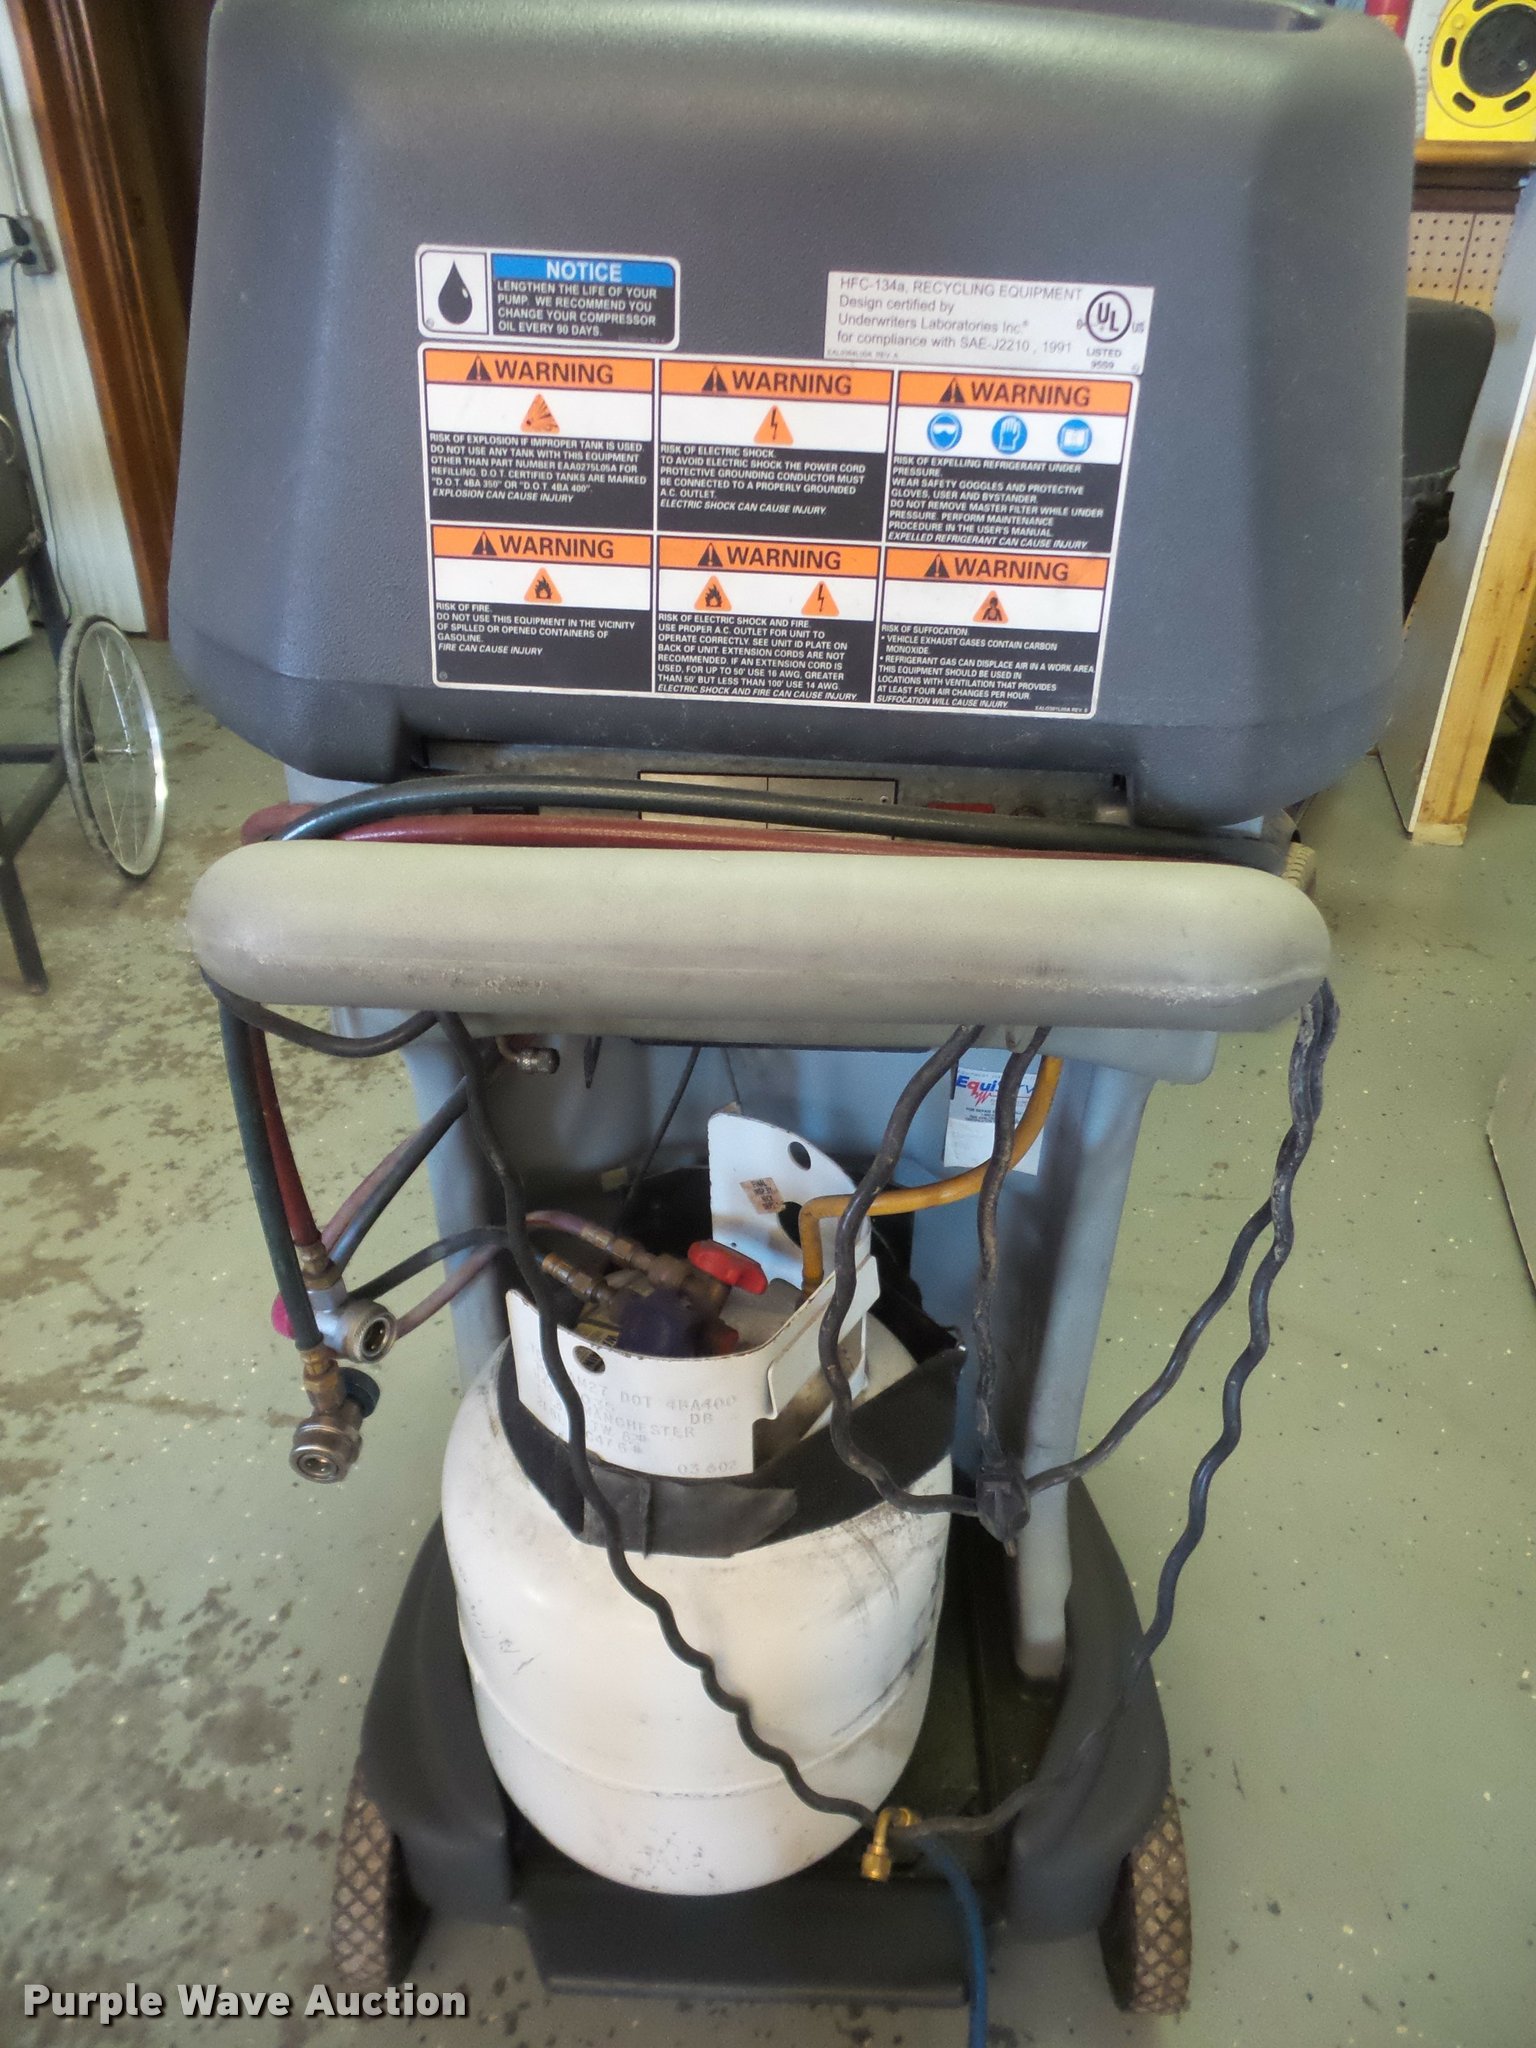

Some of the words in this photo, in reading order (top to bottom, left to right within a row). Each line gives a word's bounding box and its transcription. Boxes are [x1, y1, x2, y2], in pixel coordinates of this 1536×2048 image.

[547, 262, 621, 282] NOTICE
[498, 282, 555, 294] LENGTHEN
[559, 284, 579, 295] THE
[582, 286, 604, 297] LIFE
[608, 287, 622, 297] OF
[626, 288, 657, 299] YOUR
[912, 281, 994, 296] RECYCLING
[999, 285, 1082, 300] EQUIPMENT
[535, 296, 551, 307] WE
[555, 297, 625, 310] RECOMMEND
[629, 301, 651, 312] YOU
[840, 295, 882, 310] Design
[886, 298, 935, 312] certified
[939, 300, 954, 313] by
[498, 308, 542, 320] CHANGE
[546, 310, 576, 322] YOUR
[579, 312, 655, 326] COMPRESSOR
[839, 313, 916, 328] Underwriters
[921, 317, 997, 332] Laboratories
[1098, 302, 1119, 332] UL
[498, 321, 515, 332] OIL
[518, 322, 553, 334] EVERY
[556, 324, 568, 335] 90
[571, 325, 602, 336] DAYS.
[837, 330, 854, 344] for
[856, 331, 927, 347] compliance
[931, 335, 955, 348] with
[1044, 341, 1072, 353] 1991
[1086, 348, 1122, 358] LISTED
[495, 360, 613, 383] WARNING
[732, 370, 852, 394] WARNING
[971, 382, 1090, 406] WARNING
[430, 433, 450, 442] RISK
[452, 434, 464, 443] OF
[466, 435, 518, 446] EXPLOSION
[520, 438, 528, 446] IF
[530, 438, 577, 448] IMPROPER
[580, 441, 603, 450] TANK
[606, 442, 614, 450] IS
[431, 445, 444, 453] DO
[446, 446, 465, 454] NOT
[468, 447, 485, 455] USE
[489, 447, 507, 456] ANY
[510, 448, 534, 457] TANK
[536, 450, 560, 459] WITH
[563, 451, 583, 460] THIS
[585, 452, 639, 462] EQUIPMENT
[661, 445, 681, 454] RISK
[683, 446, 695, 454] OF
[698, 447, 739, 456] ELECTRIC
[675, 457, 704, 466] AVOID
[706, 458, 747, 468] ELECTRIC
[750, 460, 781, 469] SHOCK
[785, 462, 801, 470] THE
[804, 462, 837, 472] POWER
[839, 464, 865, 473] CORD
[893, 456, 913, 465] RISK
[916, 457, 928, 466] OF
[931, 458, 980, 468] EXPELLING
[983, 460, 1046, 471] REFRIGERANT
[1048, 463, 1081, 472] UNDER
[433, 489, 484, 499] EXPLOSION
[485, 491, 505, 500] CAN
[507, 492, 537, 501] CAUSE
[660, 500, 702, 509] ELECTRIC
[704, 502, 735, 511] SHOCK
[737, 503, 757, 512] CAN
[759, 504, 790, 513] CAUSE
[500, 535, 614, 558] WARNING
[888, 532, 933, 542] EXPELLED
[934, 534, 997, 545] REFRIGERANT
[998, 537, 1019, 546] CAN
[1020, 538, 1051, 548] CAUSE
[727, 545, 841, 569] WARNING
[955, 557, 1069, 581] WARNING
[436, 603, 455, 611] RISK
[451, 614, 469, 622] NOT
[472, 615, 489, 623] USE
[492, 616, 511, 624] THIS
[514, 617, 565, 626] EQUIPMENT
[568, 619, 577, 627] IN
[579, 620, 595, 628] THE
[598, 621, 634, 629] VICINITY
[659, 614, 677, 622] RISK
[694, 615, 734, 624] ELECTRIC
[737, 617, 766, 626] SHOCK
[769, 619, 788, 627] AND
[437, 623, 448, 631] OF
[451, 624, 484, 632] SPILLED
[501, 626, 536, 635] OPENED
[538, 628, 594, 638] CONTAINERS
[659, 624, 675, 632] USE
[678, 625, 712, 633] PROPER
[733, 627, 767, 636] OUTLET
[769, 629, 787, 637] FOR
[789, 630, 810, 638] UNIT
[813, 631, 825, 639] TO
[882, 625, 898, 633] RISK
[900, 625, 911, 633] OF
[438, 643, 456, 651] FIRE
[458, 644, 477, 652] CAN
[479, 645, 508, 654] CAUSE
[887, 635, 918, 644] VEHICLE
[920, 636, 957, 646] EXHAUST
[959, 638, 985, 647] GASES
[987, 640, 1022, 649] CONTAIN
[1023, 641, 1057, 650] CARBON
[658, 684, 697, 694] ELECTRIC
[699, 686, 729, 695] SHOCK
[731, 688, 750, 696] AND
[752, 689, 770, 697] FIRE
[772, 690, 791, 698] CAN
[793, 691, 822, 699] CAUSE
